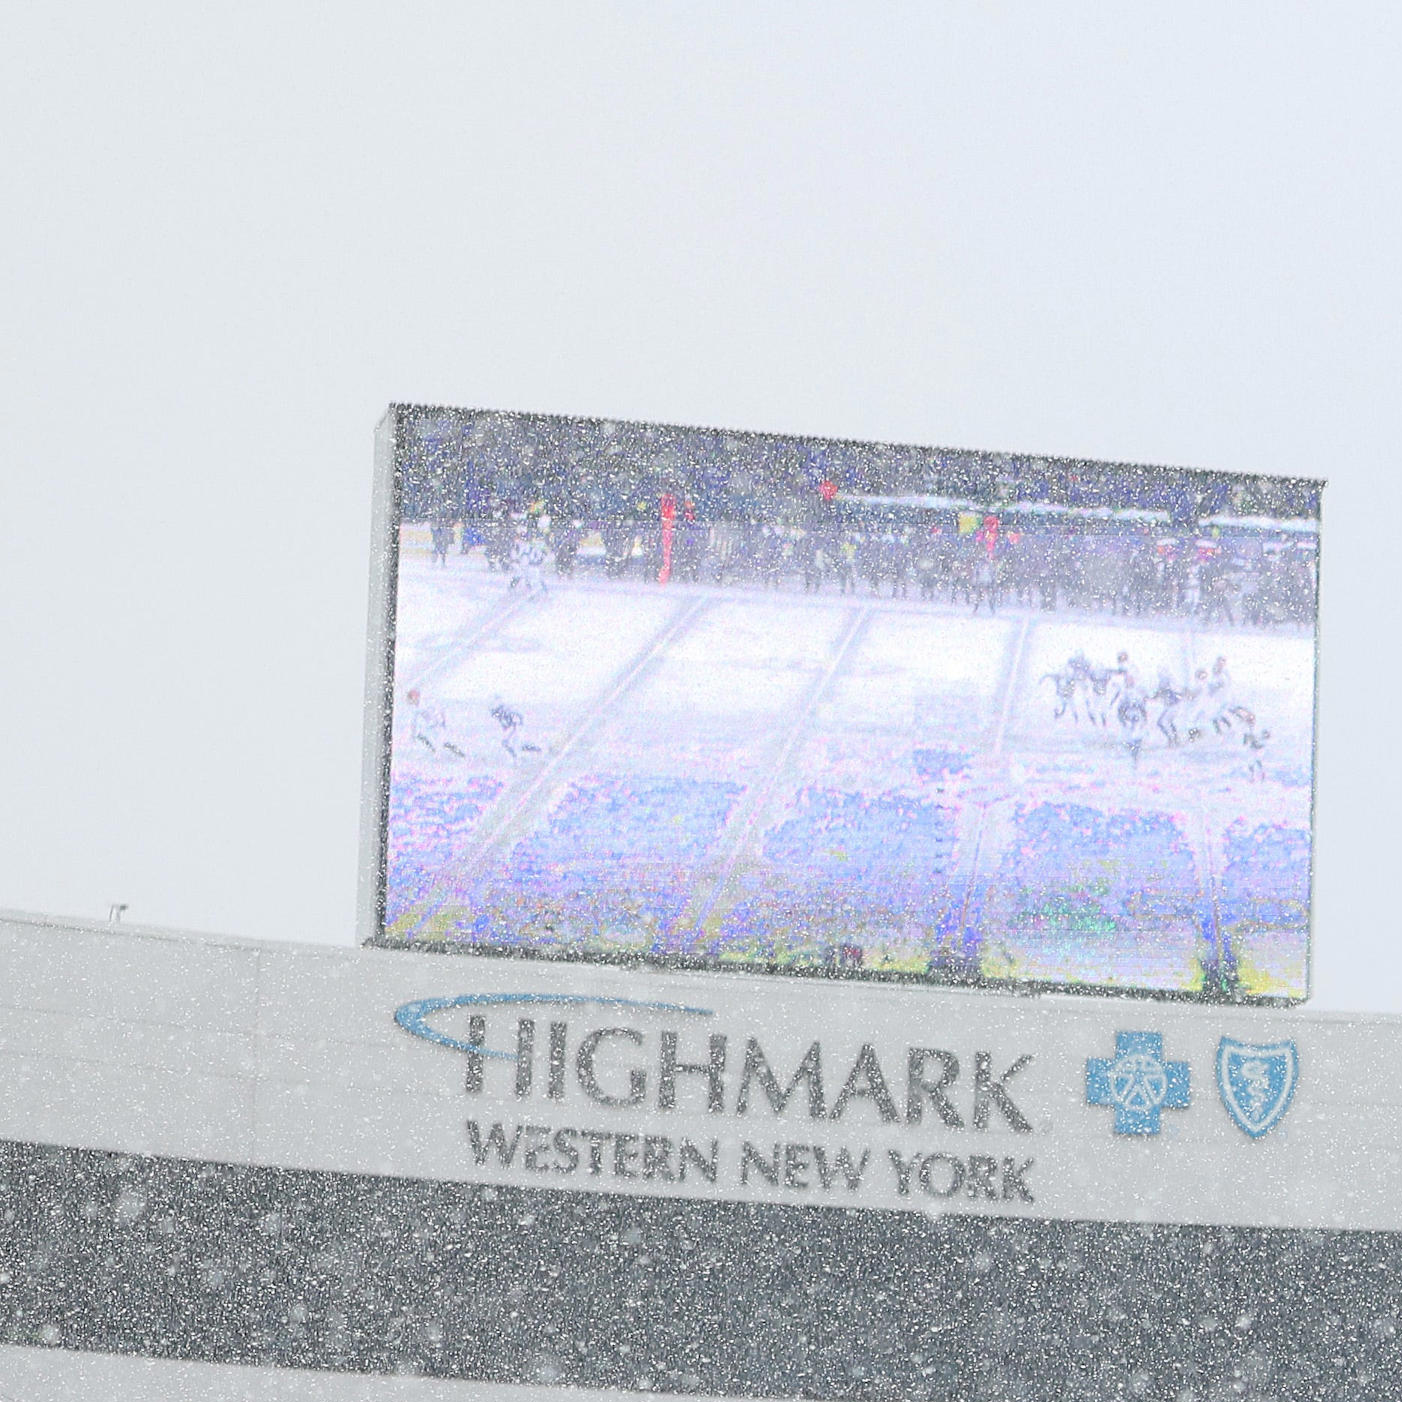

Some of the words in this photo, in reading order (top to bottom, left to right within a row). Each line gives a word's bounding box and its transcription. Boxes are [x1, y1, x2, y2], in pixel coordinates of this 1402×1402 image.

[464, 1014, 1035, 1134] HIGHMARK
[465, 1119, 719, 1184] WESTERN
[738, 1140, 871, 1192] NEW
[886, 1148, 1036, 1202] YORK
